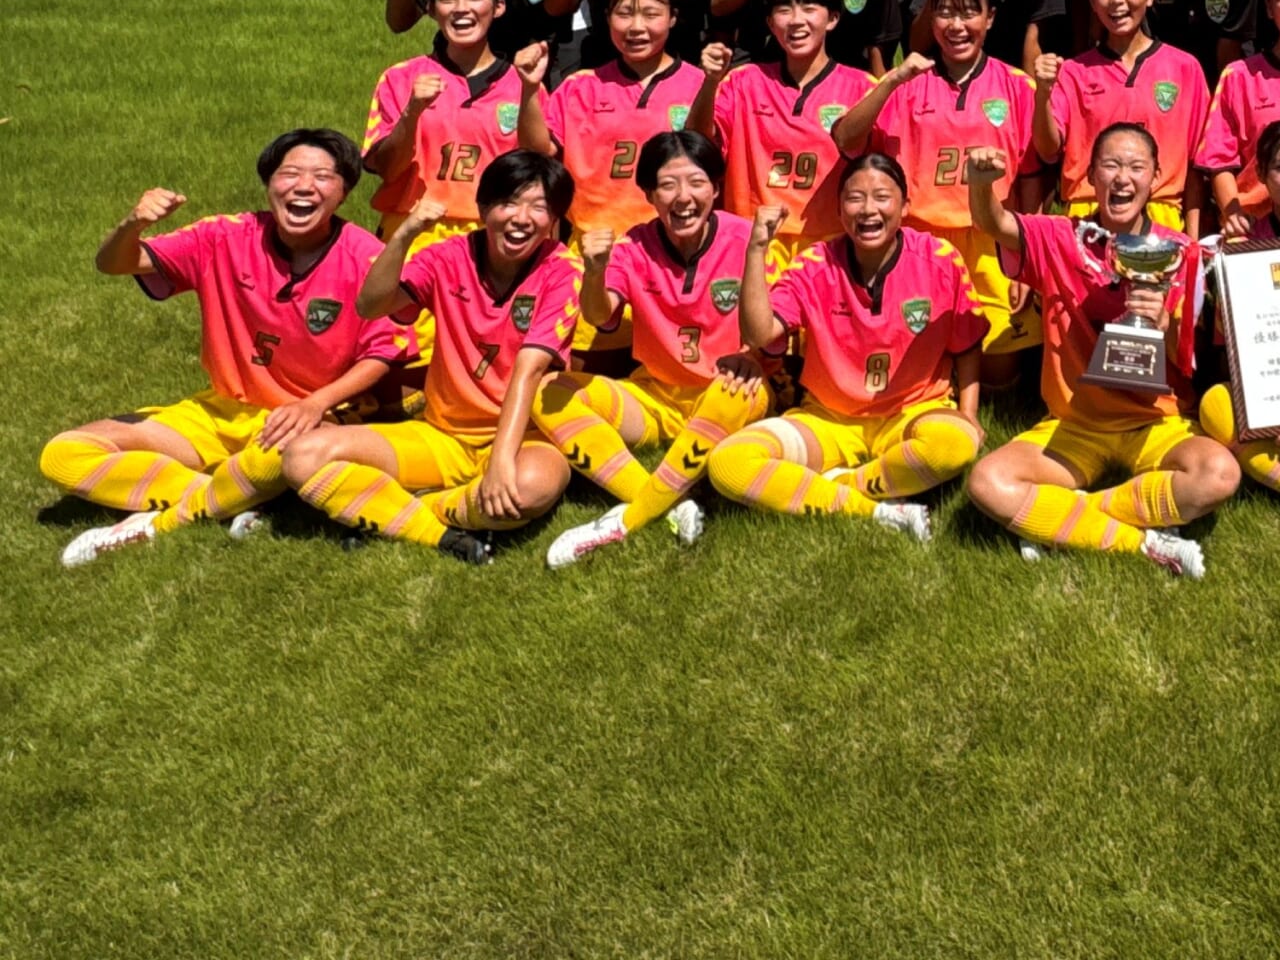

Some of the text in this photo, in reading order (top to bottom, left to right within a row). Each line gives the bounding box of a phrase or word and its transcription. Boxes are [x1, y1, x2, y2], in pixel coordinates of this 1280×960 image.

[437, 141, 481, 182] 12
[766, 151, 818, 190] 29
[251, 331, 281, 367] 5
[474, 343, 501, 380] 7
[678, 326, 701, 364] 3
[864, 352, 891, 393] 8
